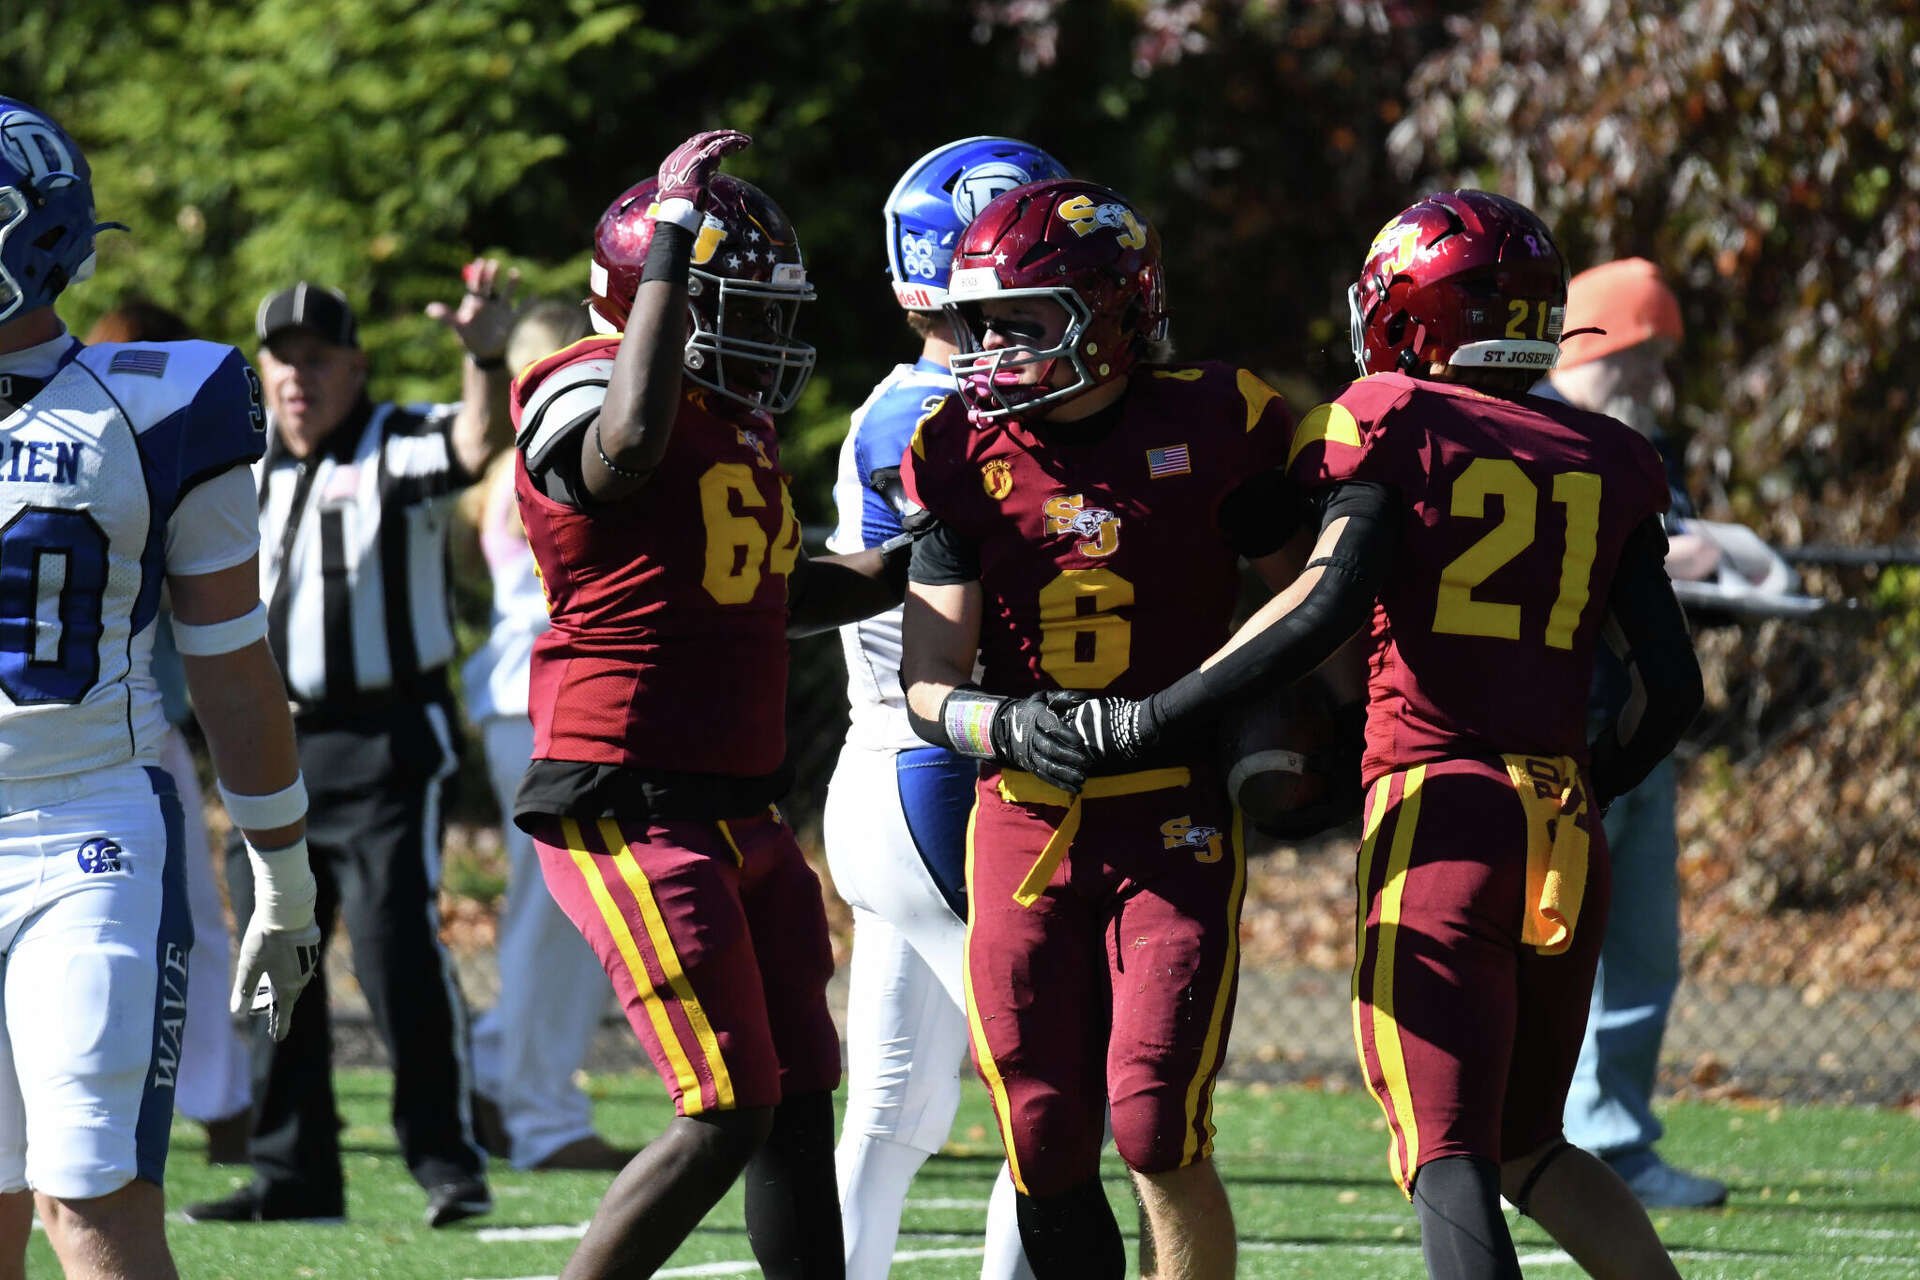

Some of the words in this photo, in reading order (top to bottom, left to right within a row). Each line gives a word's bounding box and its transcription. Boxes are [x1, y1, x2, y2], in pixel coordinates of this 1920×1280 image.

[1483, 350, 1505, 363] ST
[1507, 350, 1554, 366] JOSEPH
[1504, 299, 1547, 339] 21
[0, 440, 84, 485] IEN
[698, 461, 803, 606] 64
[1431, 457, 1602, 651] 21
[1039, 568, 1136, 690] 6
[154, 941, 189, 1089] WAVE
